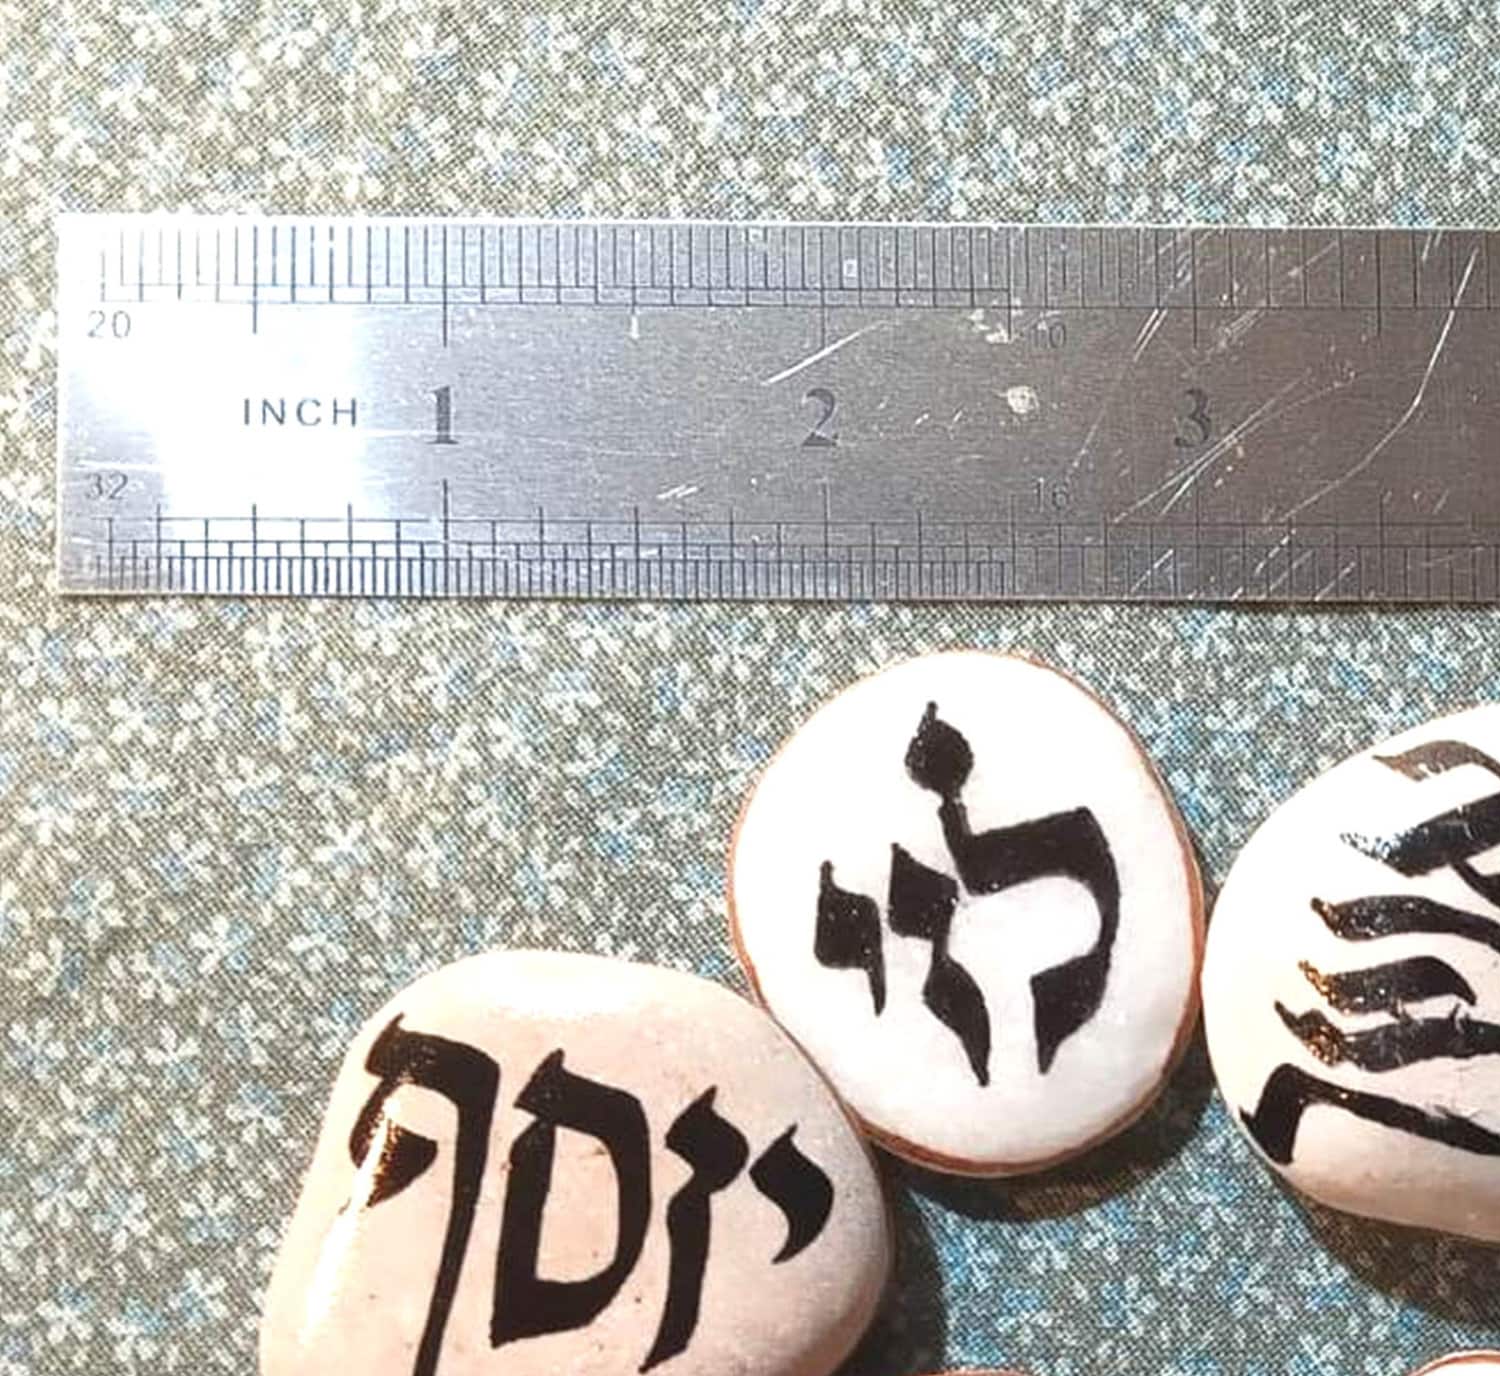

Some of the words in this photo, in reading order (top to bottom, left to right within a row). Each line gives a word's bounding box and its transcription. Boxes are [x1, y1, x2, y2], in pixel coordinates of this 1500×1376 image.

[87, 310, 131, 338] 20
[243, 398, 358, 426] INCH
[433, 386, 458, 444] 1
[801, 388, 837, 446] 2
[1174, 389, 1212, 447] 3
[86, 473, 128, 498] 32
[815, 701, 1120, 1087] לוי
